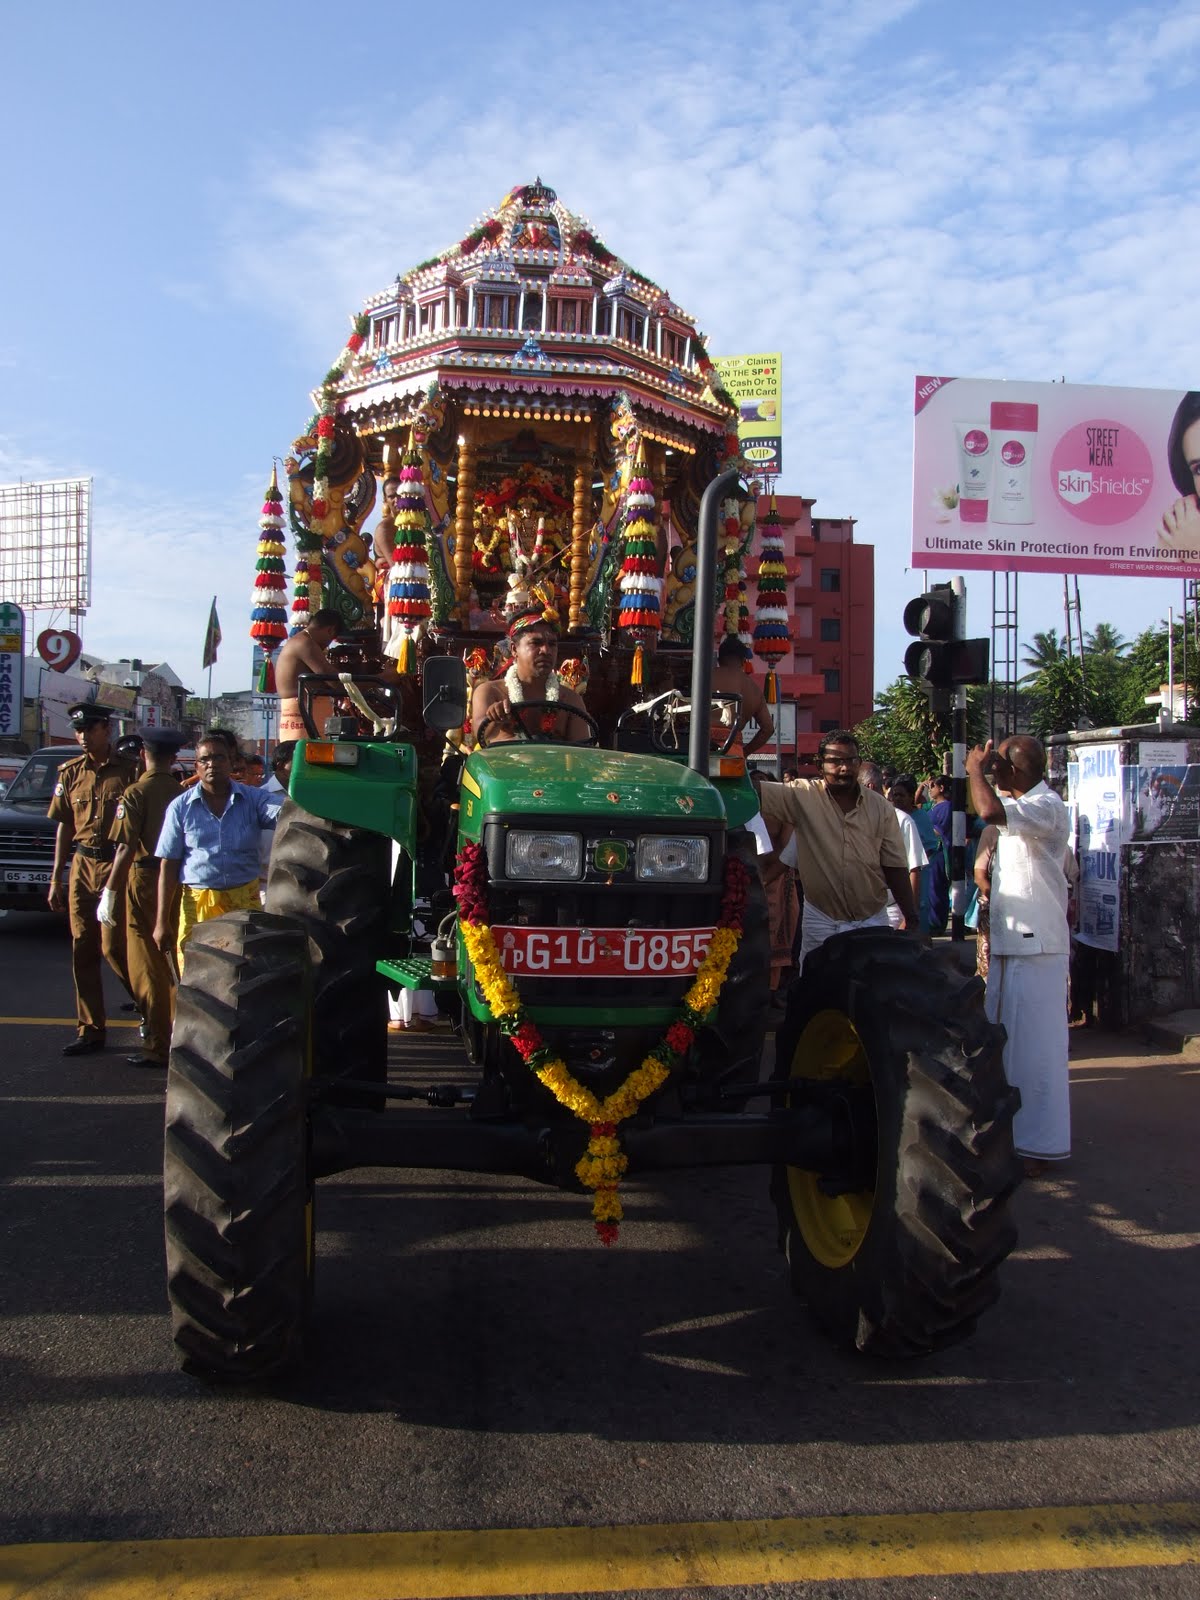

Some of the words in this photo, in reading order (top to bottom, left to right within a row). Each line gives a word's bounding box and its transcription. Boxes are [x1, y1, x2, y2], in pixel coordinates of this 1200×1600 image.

[747, 358, 777, 366] Claims
[730, 379, 752, 387] Cash
[754, 378, 764, 386] Or
[735, 389, 754, 397] ATM
[756, 388, 777, 396] Card
[918, 376, 942, 399] NEW
[1086, 427, 1119, 447] STREET
[751, 449, 769, 459] VIP
[1089, 446, 1113, 467] WEAR
[925, 537, 983, 550] Ultimate
[987, 539, 1016, 552] Skin
[1021, 540, 1088, 554] Protection
[1093, 543, 1124, 556] from
[1129, 546, 1200, 559] Environme
[1109, 562, 1134, 570] STREET
[1135, 563, 1154, 571] WEAR
[1155, 564, 1191, 572] SKINSHIELD
[46, 635, 70, 665] 9
[0, 653, 12, 733] PHARMACY
[1096, 750, 1116, 777] UK
[1097, 851, 1116, 880] UK
